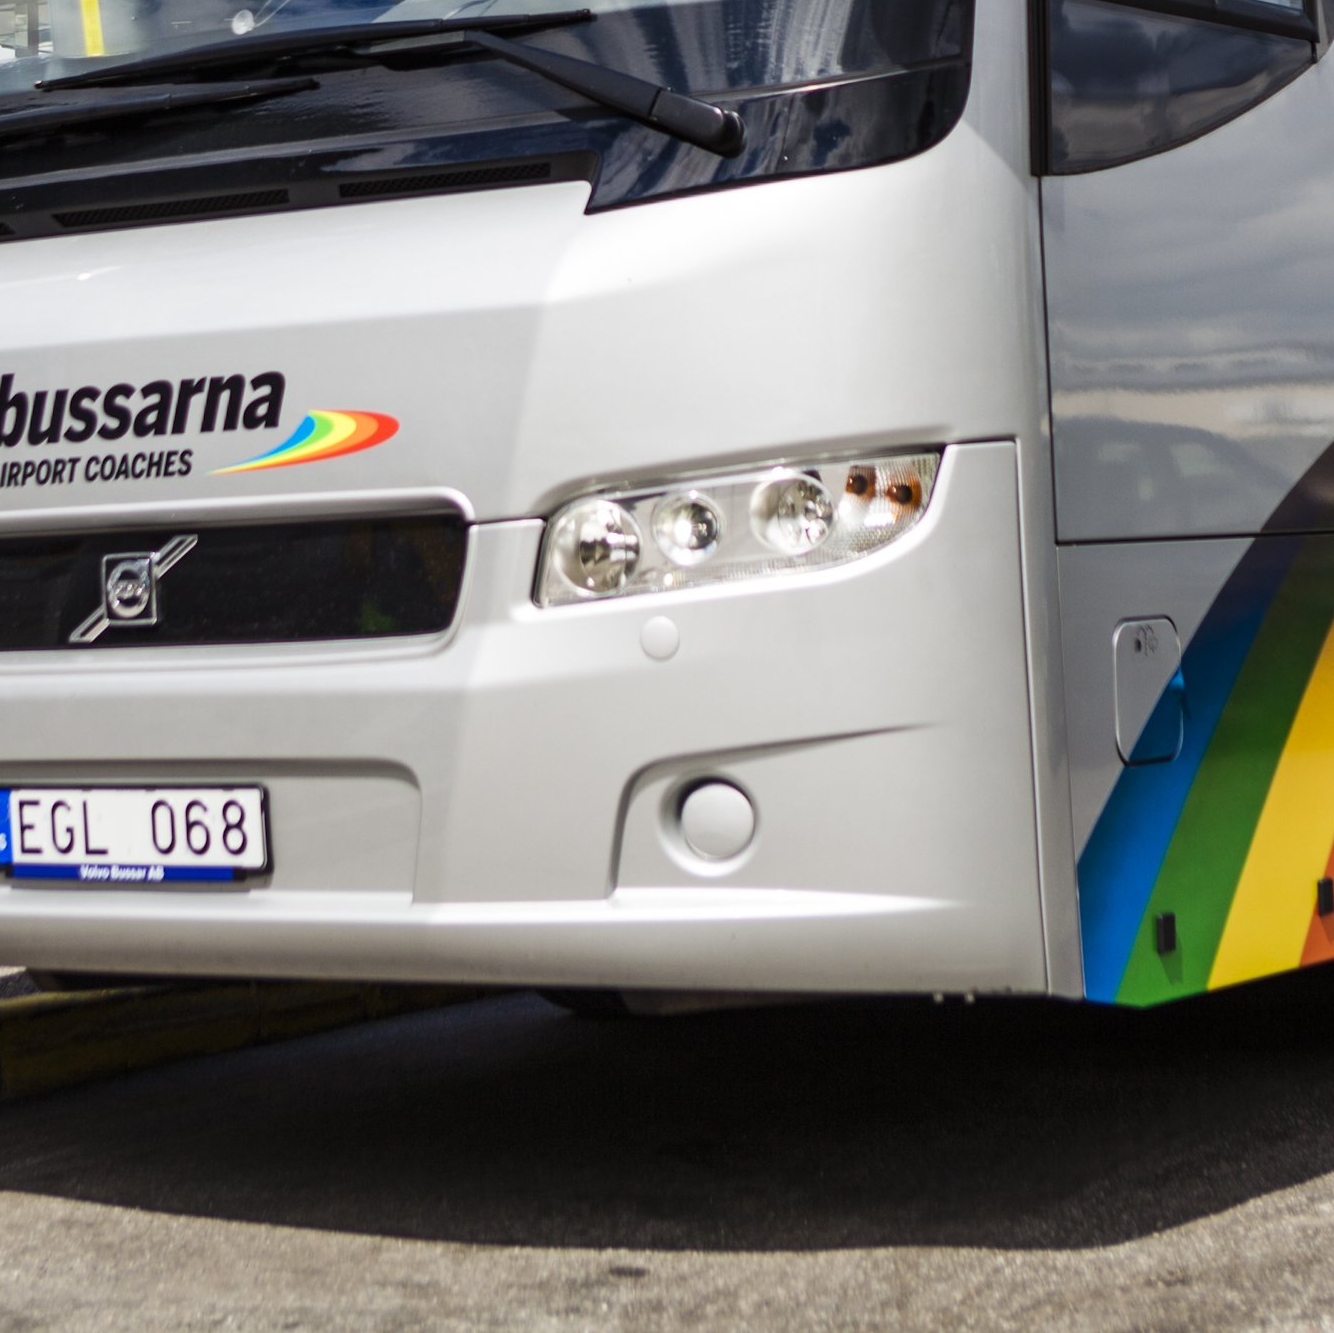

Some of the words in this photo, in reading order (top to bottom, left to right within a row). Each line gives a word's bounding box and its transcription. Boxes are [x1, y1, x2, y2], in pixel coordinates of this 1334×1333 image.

[85, 449, 194, 483] COACHES
[18, 799, 109, 856] EGL
[151, 798, 248, 856] 068
